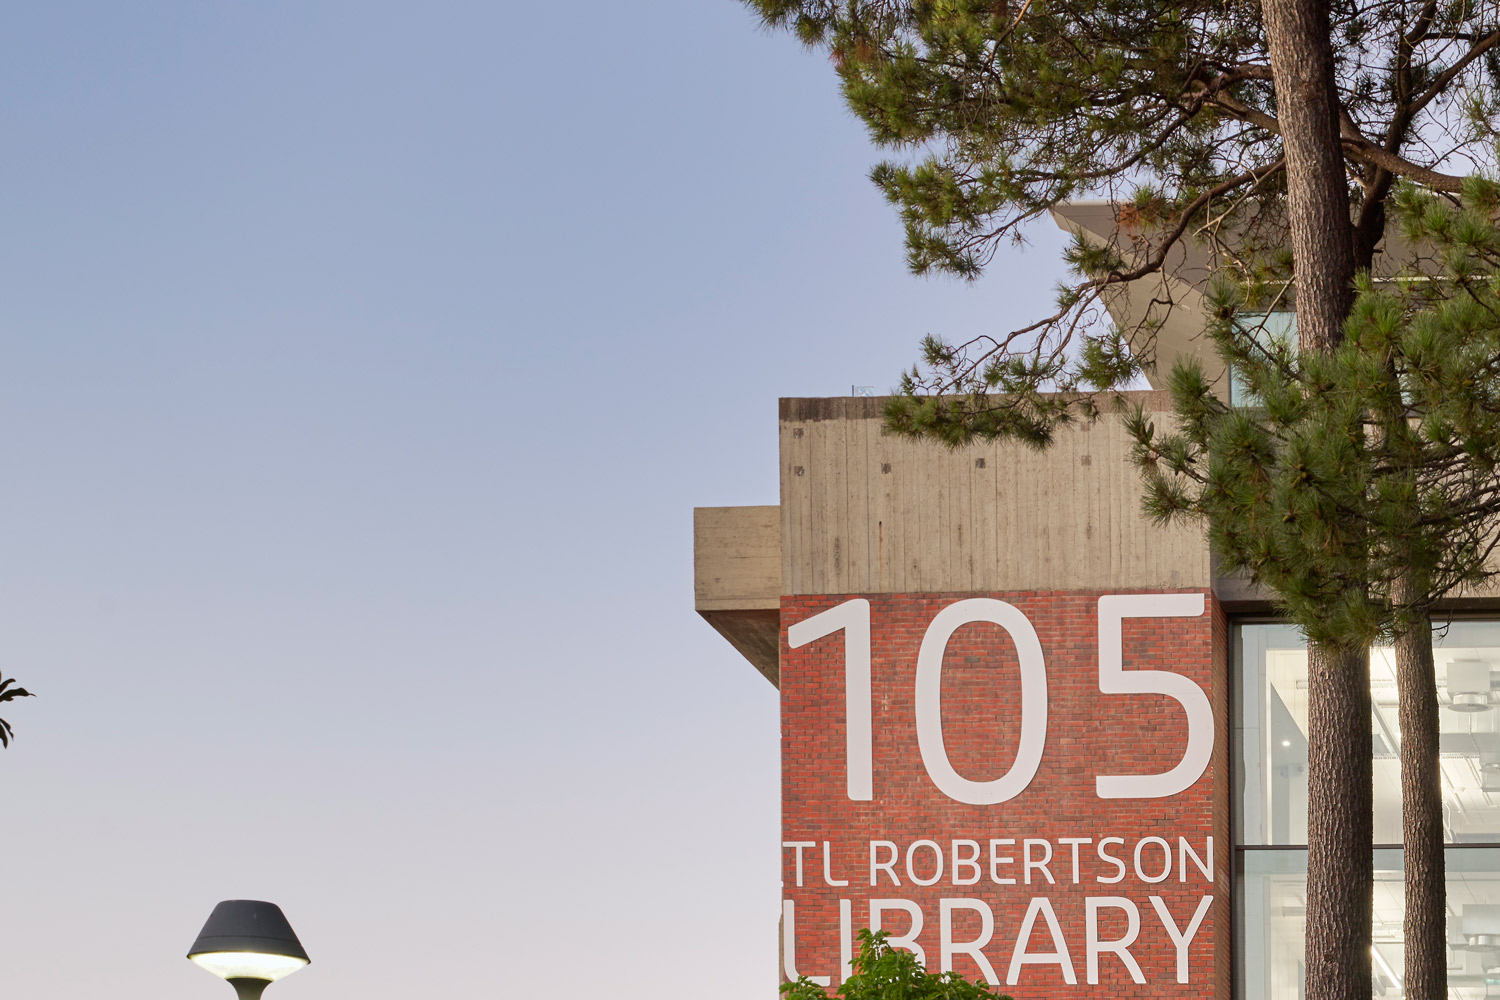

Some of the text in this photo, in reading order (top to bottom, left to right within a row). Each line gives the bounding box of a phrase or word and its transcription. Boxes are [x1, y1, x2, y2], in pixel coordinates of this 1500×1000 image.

[788, 593, 1215, 805] 105
[782, 836, 1214, 887] TL ROBERTSON
[783, 895, 1214, 987] LIBRARY
